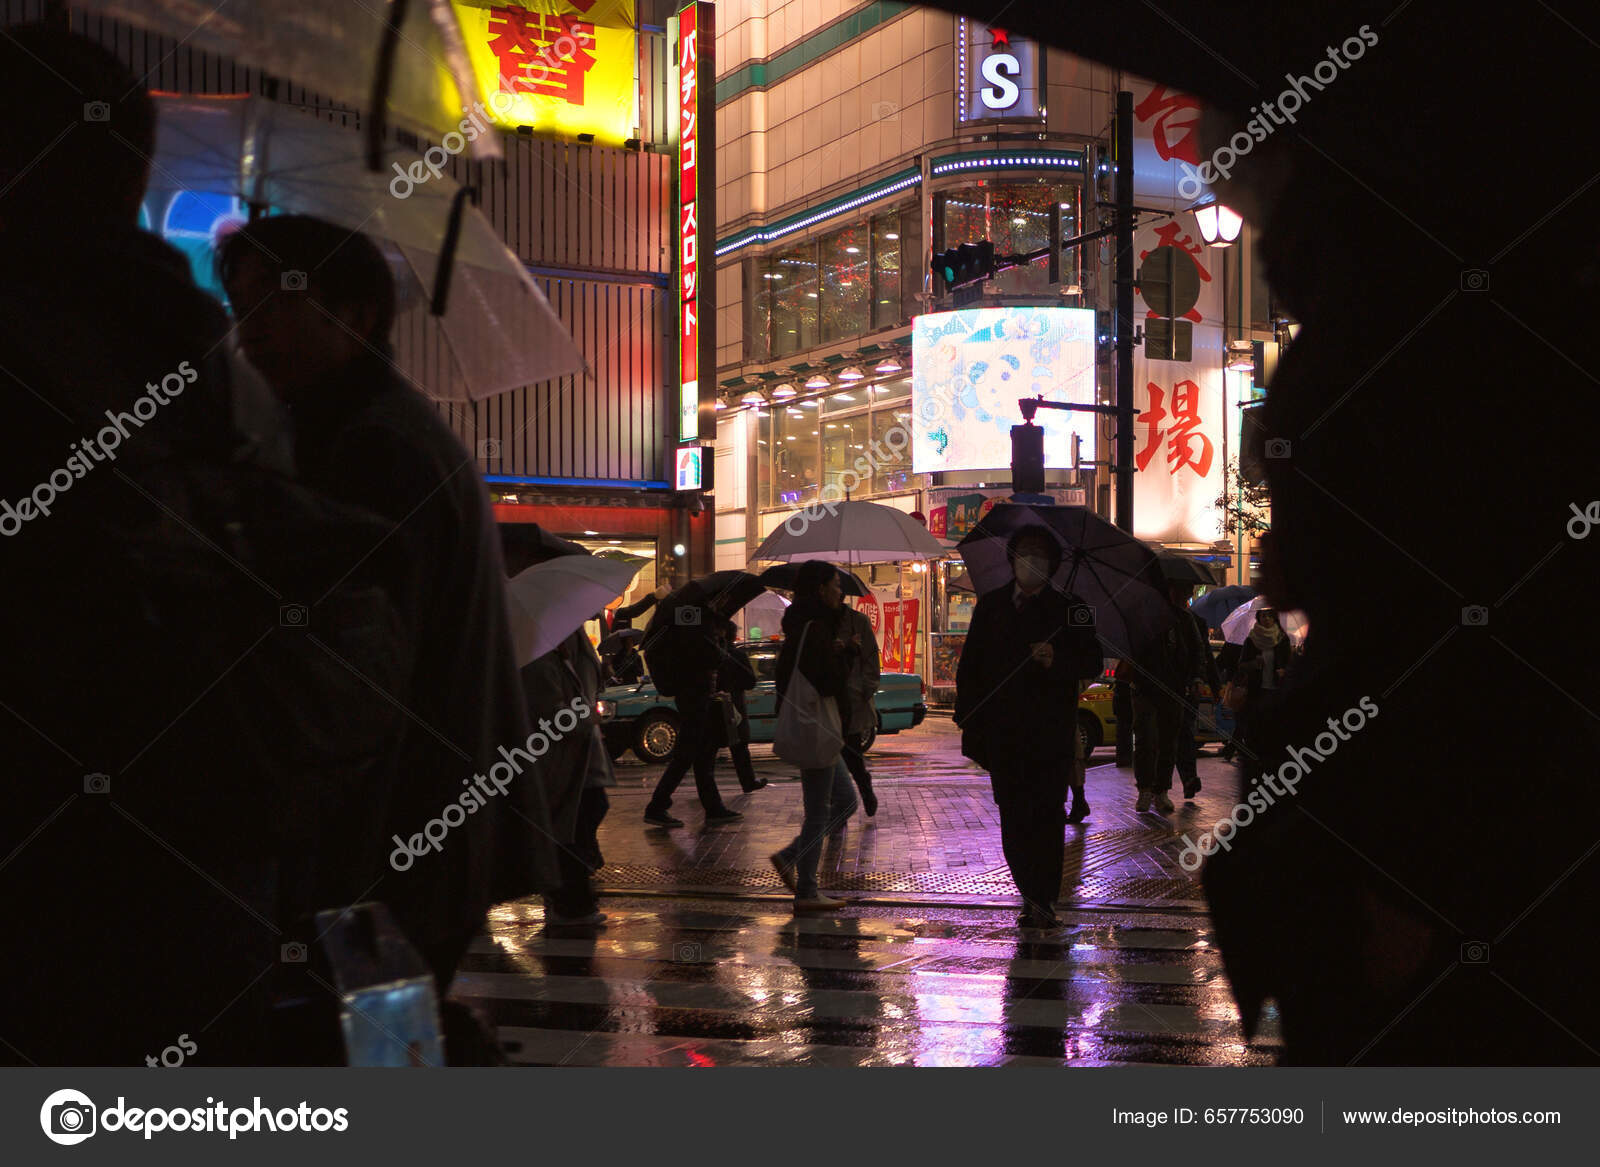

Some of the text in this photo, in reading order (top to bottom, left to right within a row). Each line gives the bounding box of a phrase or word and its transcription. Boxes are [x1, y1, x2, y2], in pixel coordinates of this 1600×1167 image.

[487, 0, 597, 106] 替
[980, 53, 1020, 110] S
[681, 30, 697, 336] パチンコ スロット
